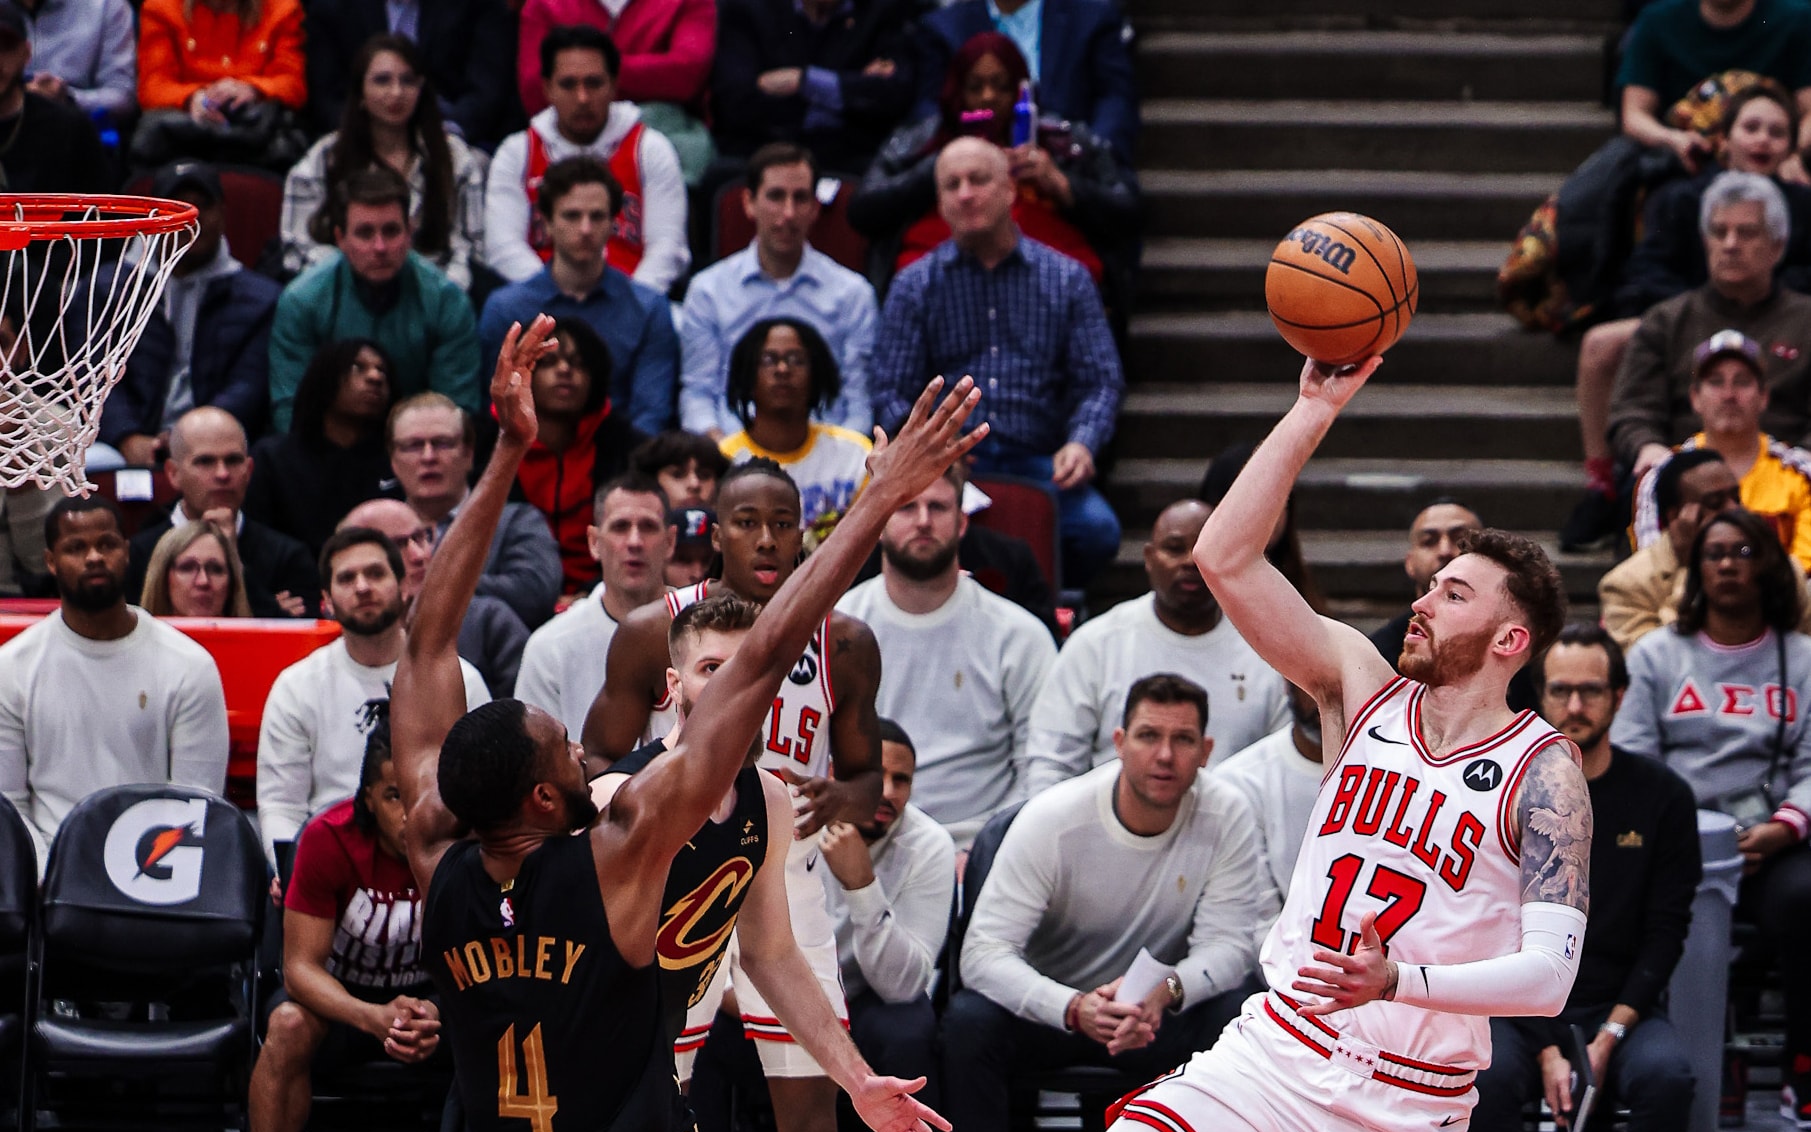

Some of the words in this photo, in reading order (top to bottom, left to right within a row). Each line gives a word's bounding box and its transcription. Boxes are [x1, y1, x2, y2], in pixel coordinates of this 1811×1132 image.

[103, 798, 208, 906] G
[1318, 765, 1486, 893] BULLS
[1311, 853, 1427, 959] 17
[444, 935, 586, 991] MOBLEY
